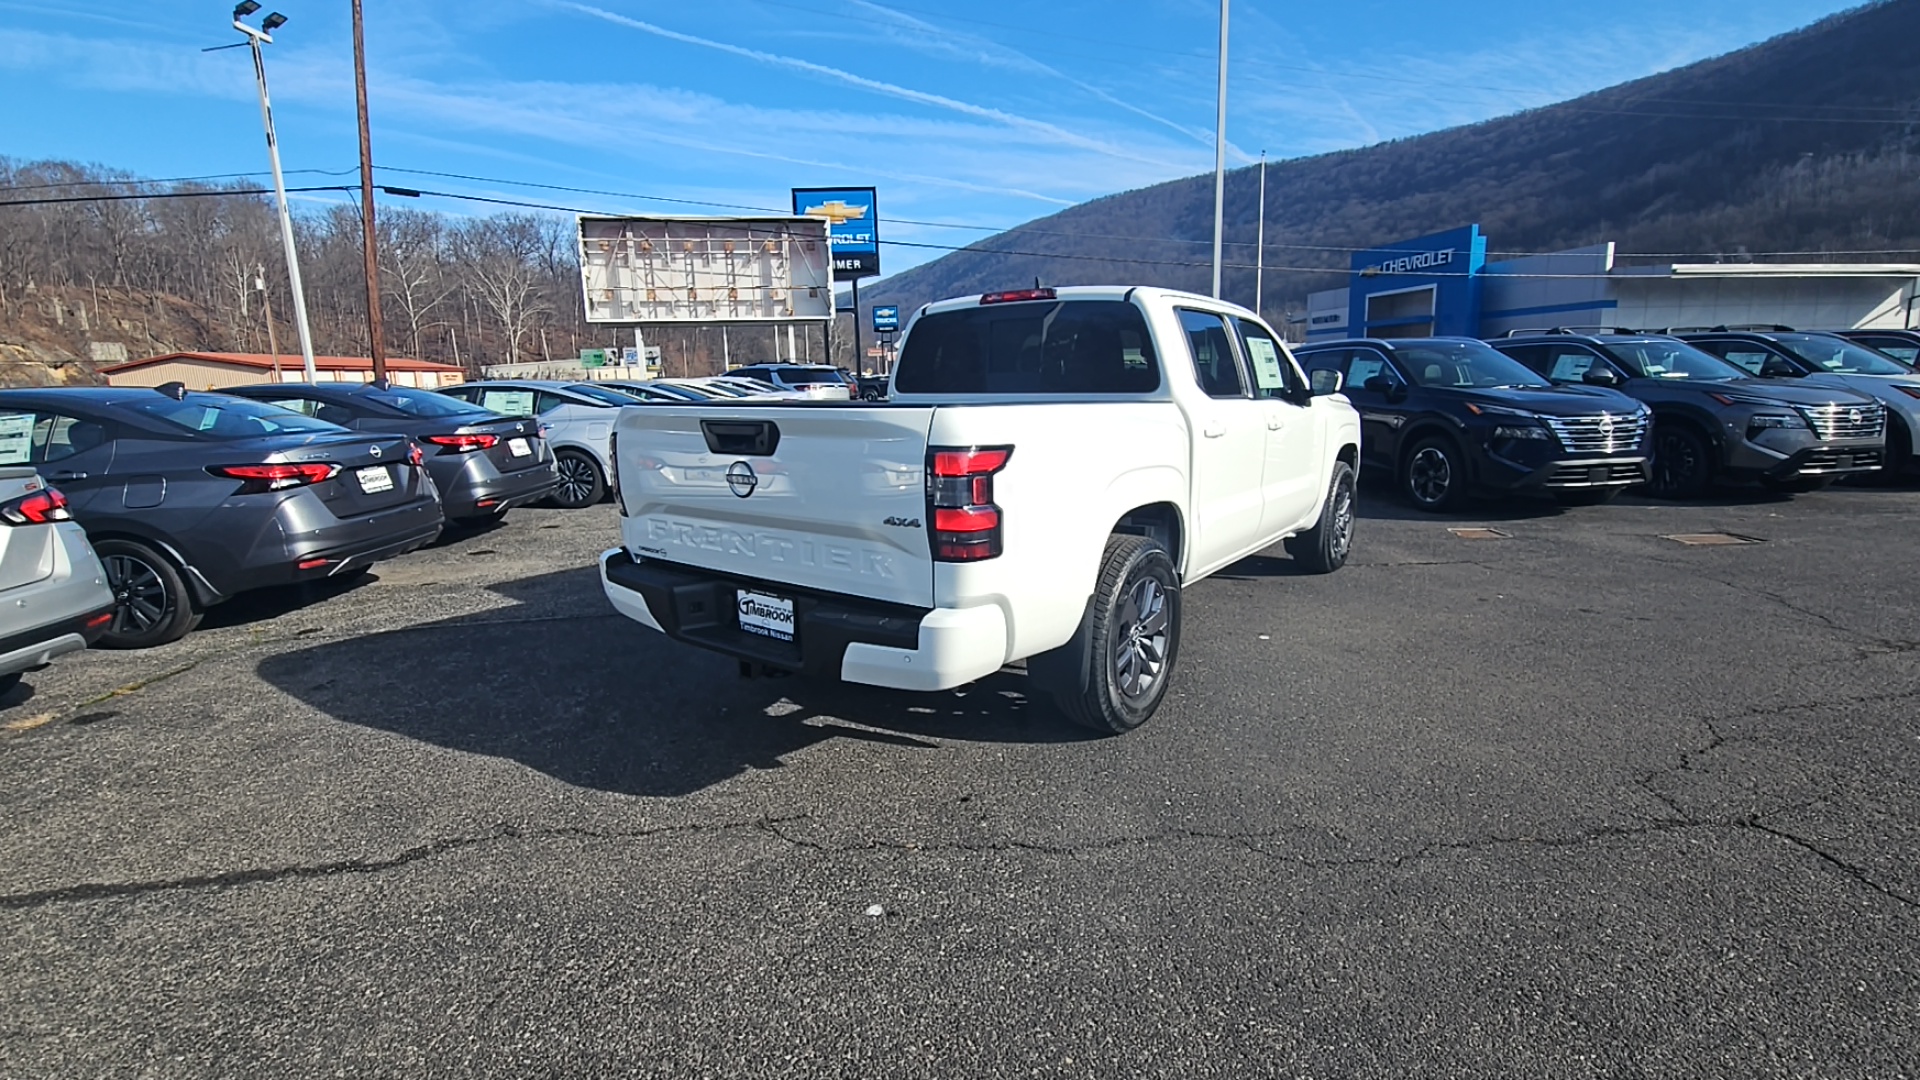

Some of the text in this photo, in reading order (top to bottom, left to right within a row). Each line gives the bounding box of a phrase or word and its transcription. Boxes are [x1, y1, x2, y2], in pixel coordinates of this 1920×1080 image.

[831, 233, 871, 244] ROLET
[832, 259, 861, 270] IMER
[1383, 248, 1455, 273] CHEVROLET
[739, 597, 793, 624] TIMBROOK
[740, 622, 793, 642] Timbrook Nissan
